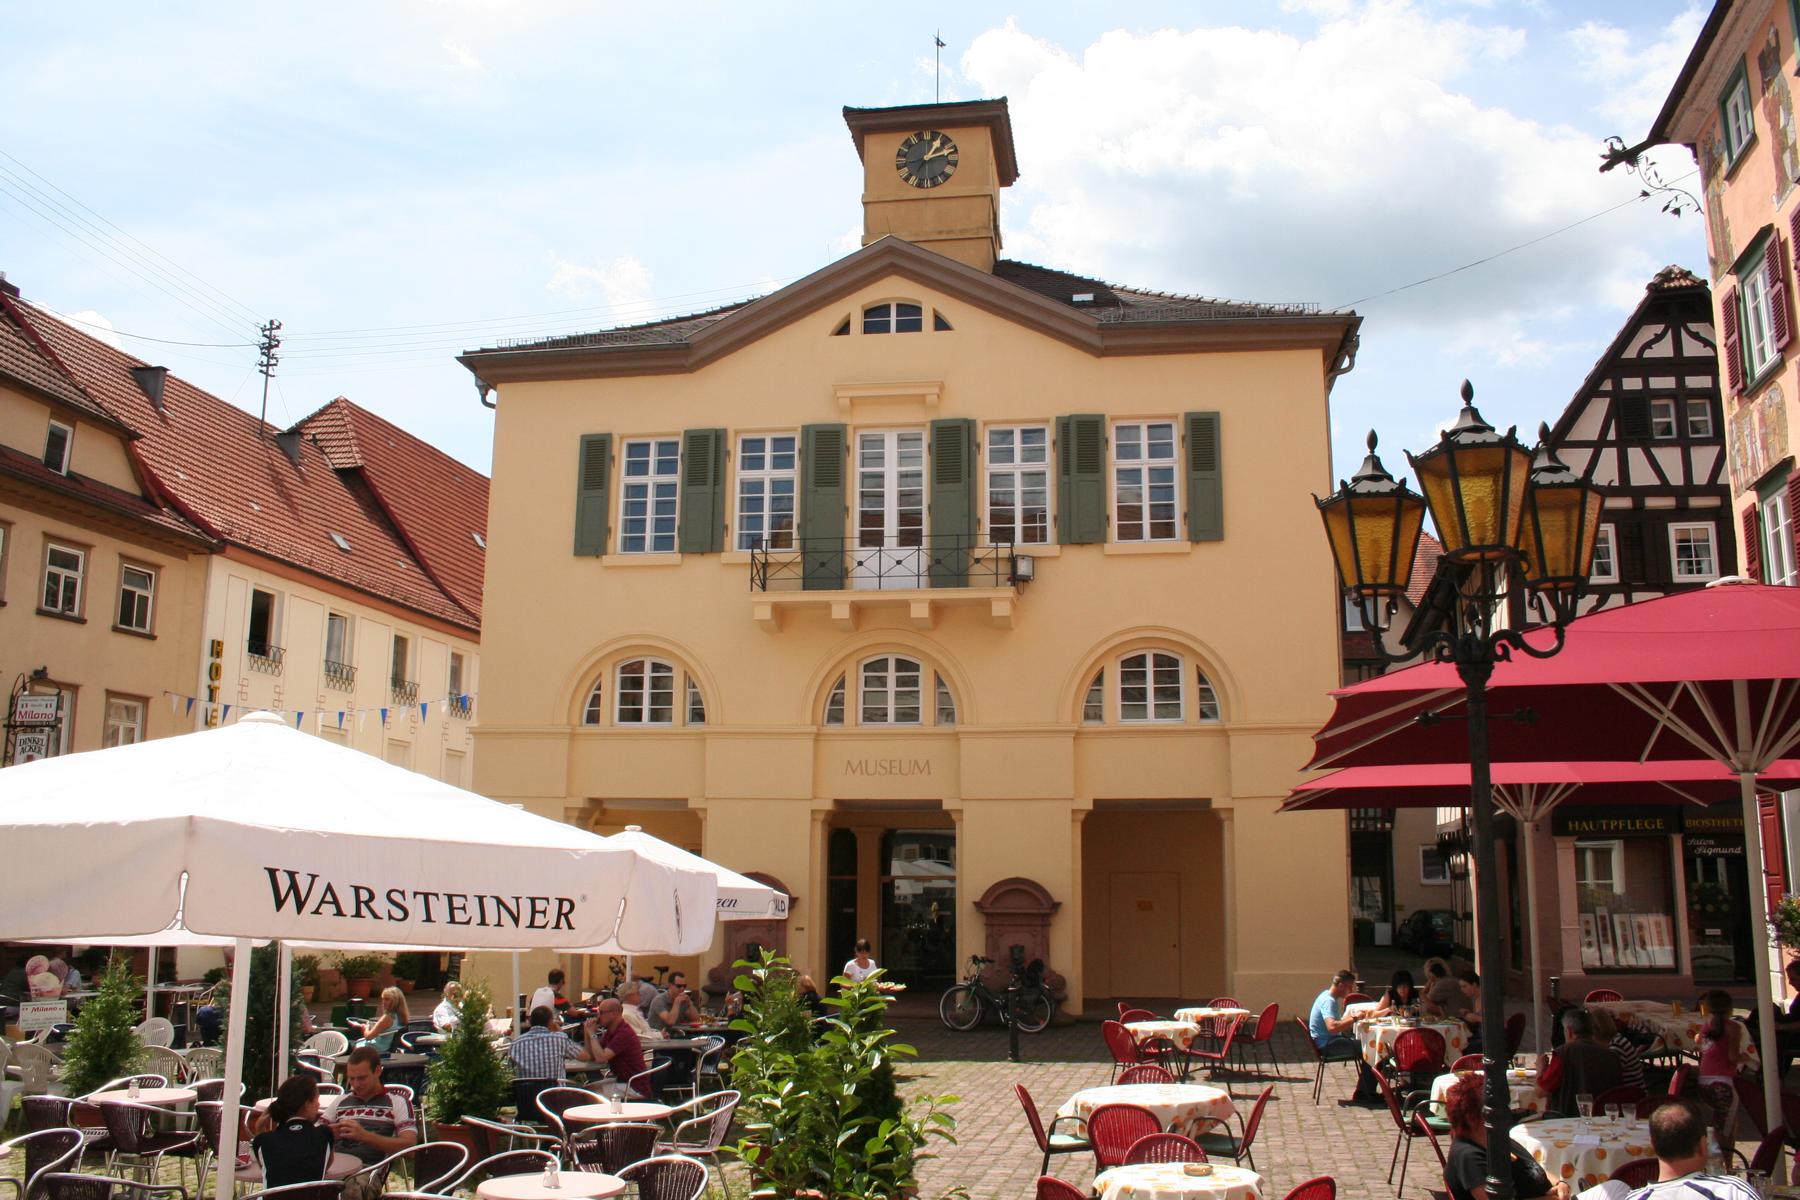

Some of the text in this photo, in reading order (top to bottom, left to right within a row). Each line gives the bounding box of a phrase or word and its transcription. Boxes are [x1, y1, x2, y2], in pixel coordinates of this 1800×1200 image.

[206, 639, 223, 728] HOTE
[18, 710, 54, 720] Milano
[19, 736, 45, 747] DINKEL
[20, 745, 43, 755] ACKER
[845, 759, 932, 776] MUSEUM
[1568, 818, 1665, 832] HAUTPFLEGE
[1685, 818, 1744, 828] BIOSTHETI
[263, 866, 576, 931] WARSTEINER
